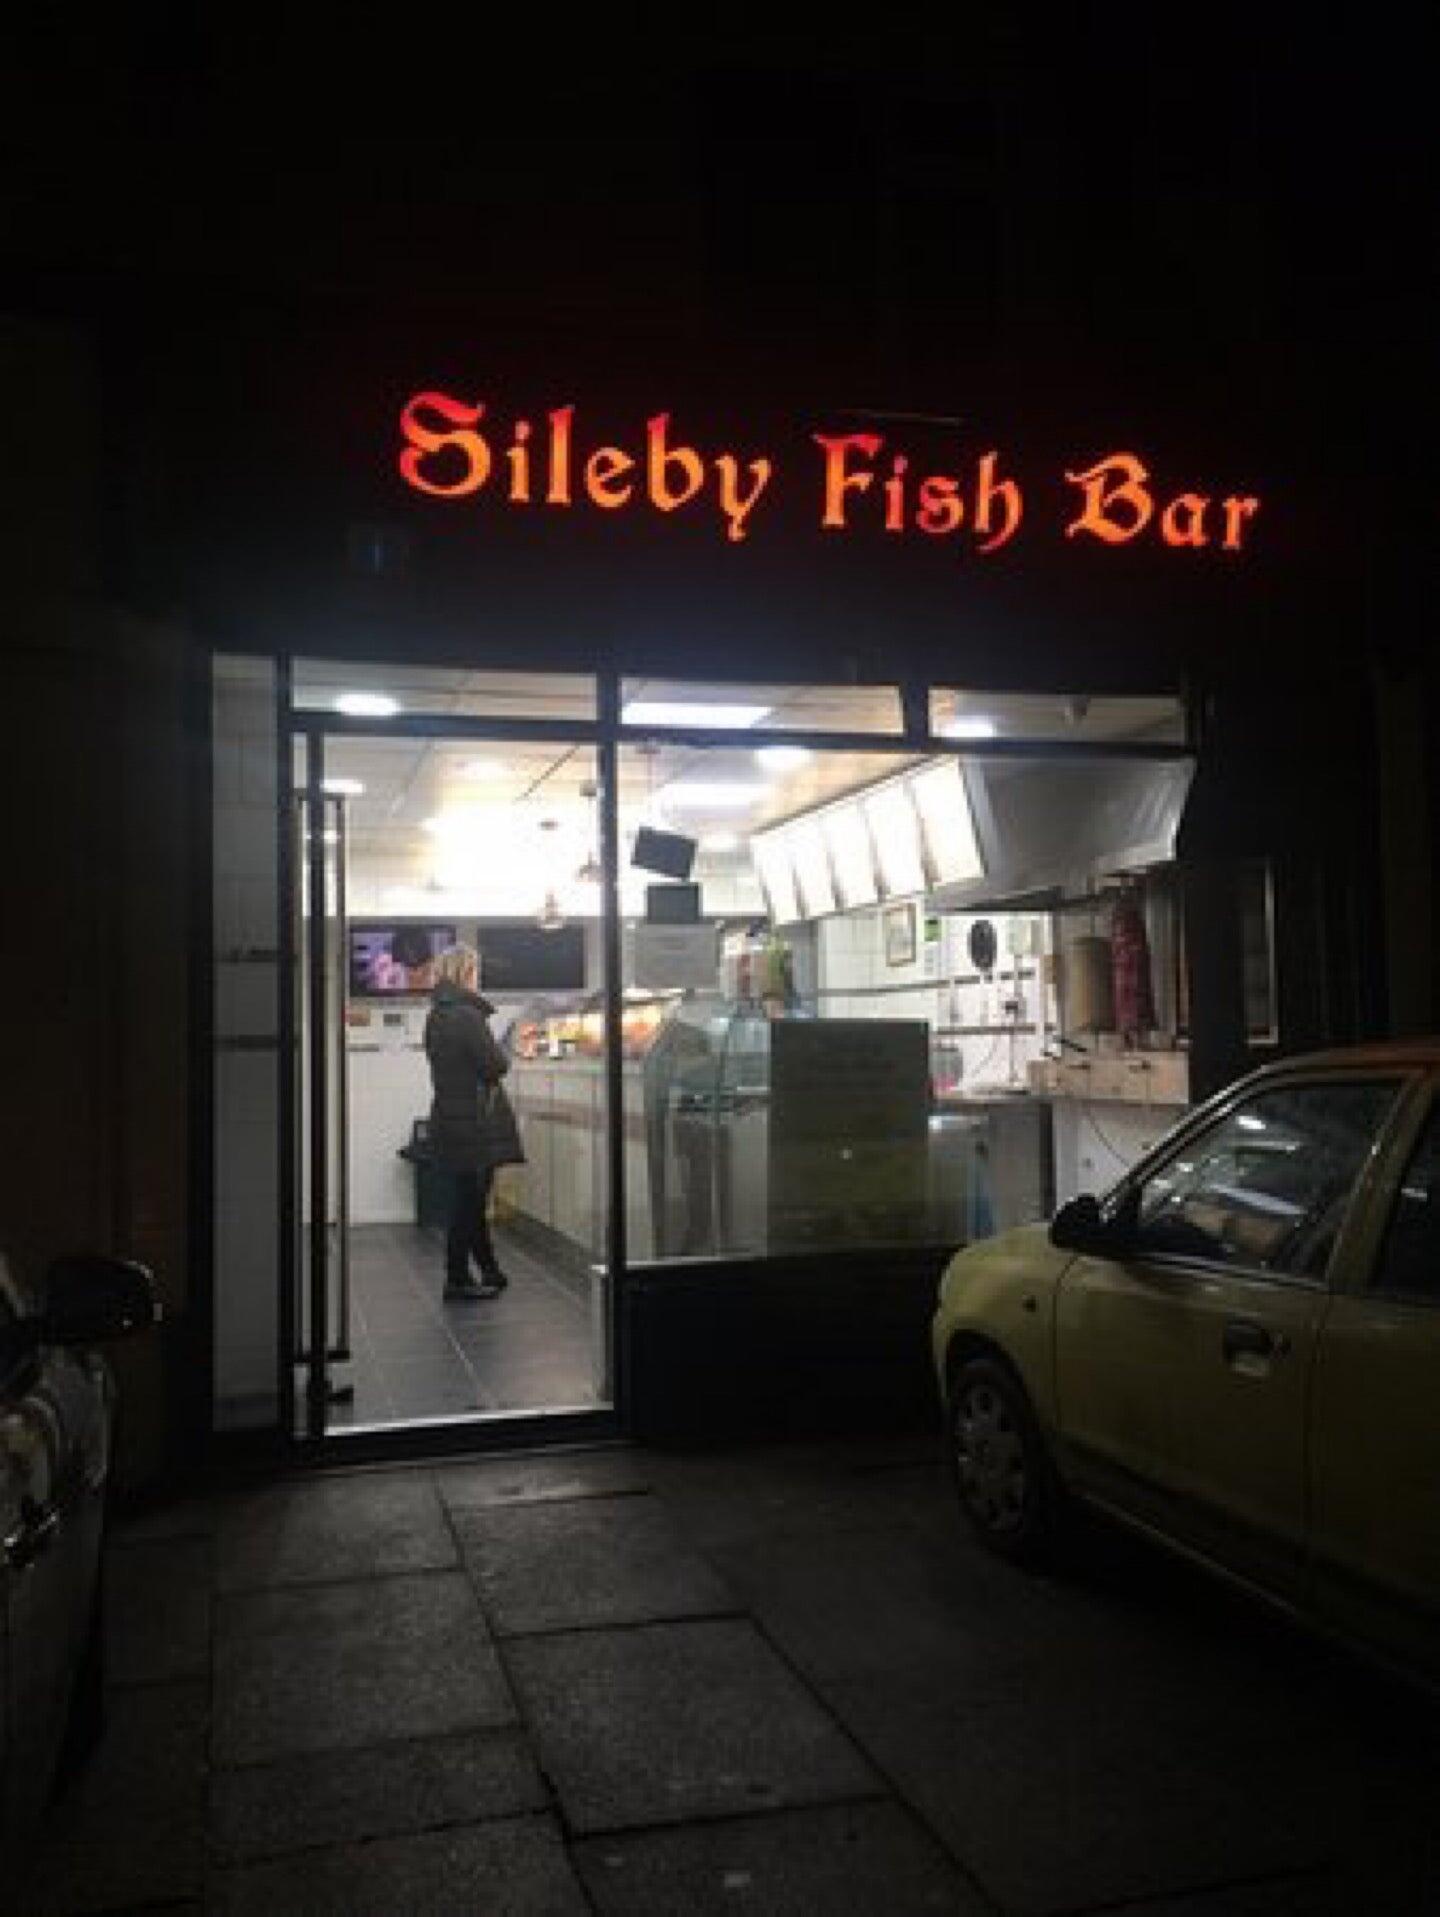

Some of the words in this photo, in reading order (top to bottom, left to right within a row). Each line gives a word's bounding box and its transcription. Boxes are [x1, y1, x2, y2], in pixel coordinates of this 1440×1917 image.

[399, 391, 772, 540] Sileby
[813, 432, 1024, 552] Fish
[1064, 452, 1260, 551] Bar
